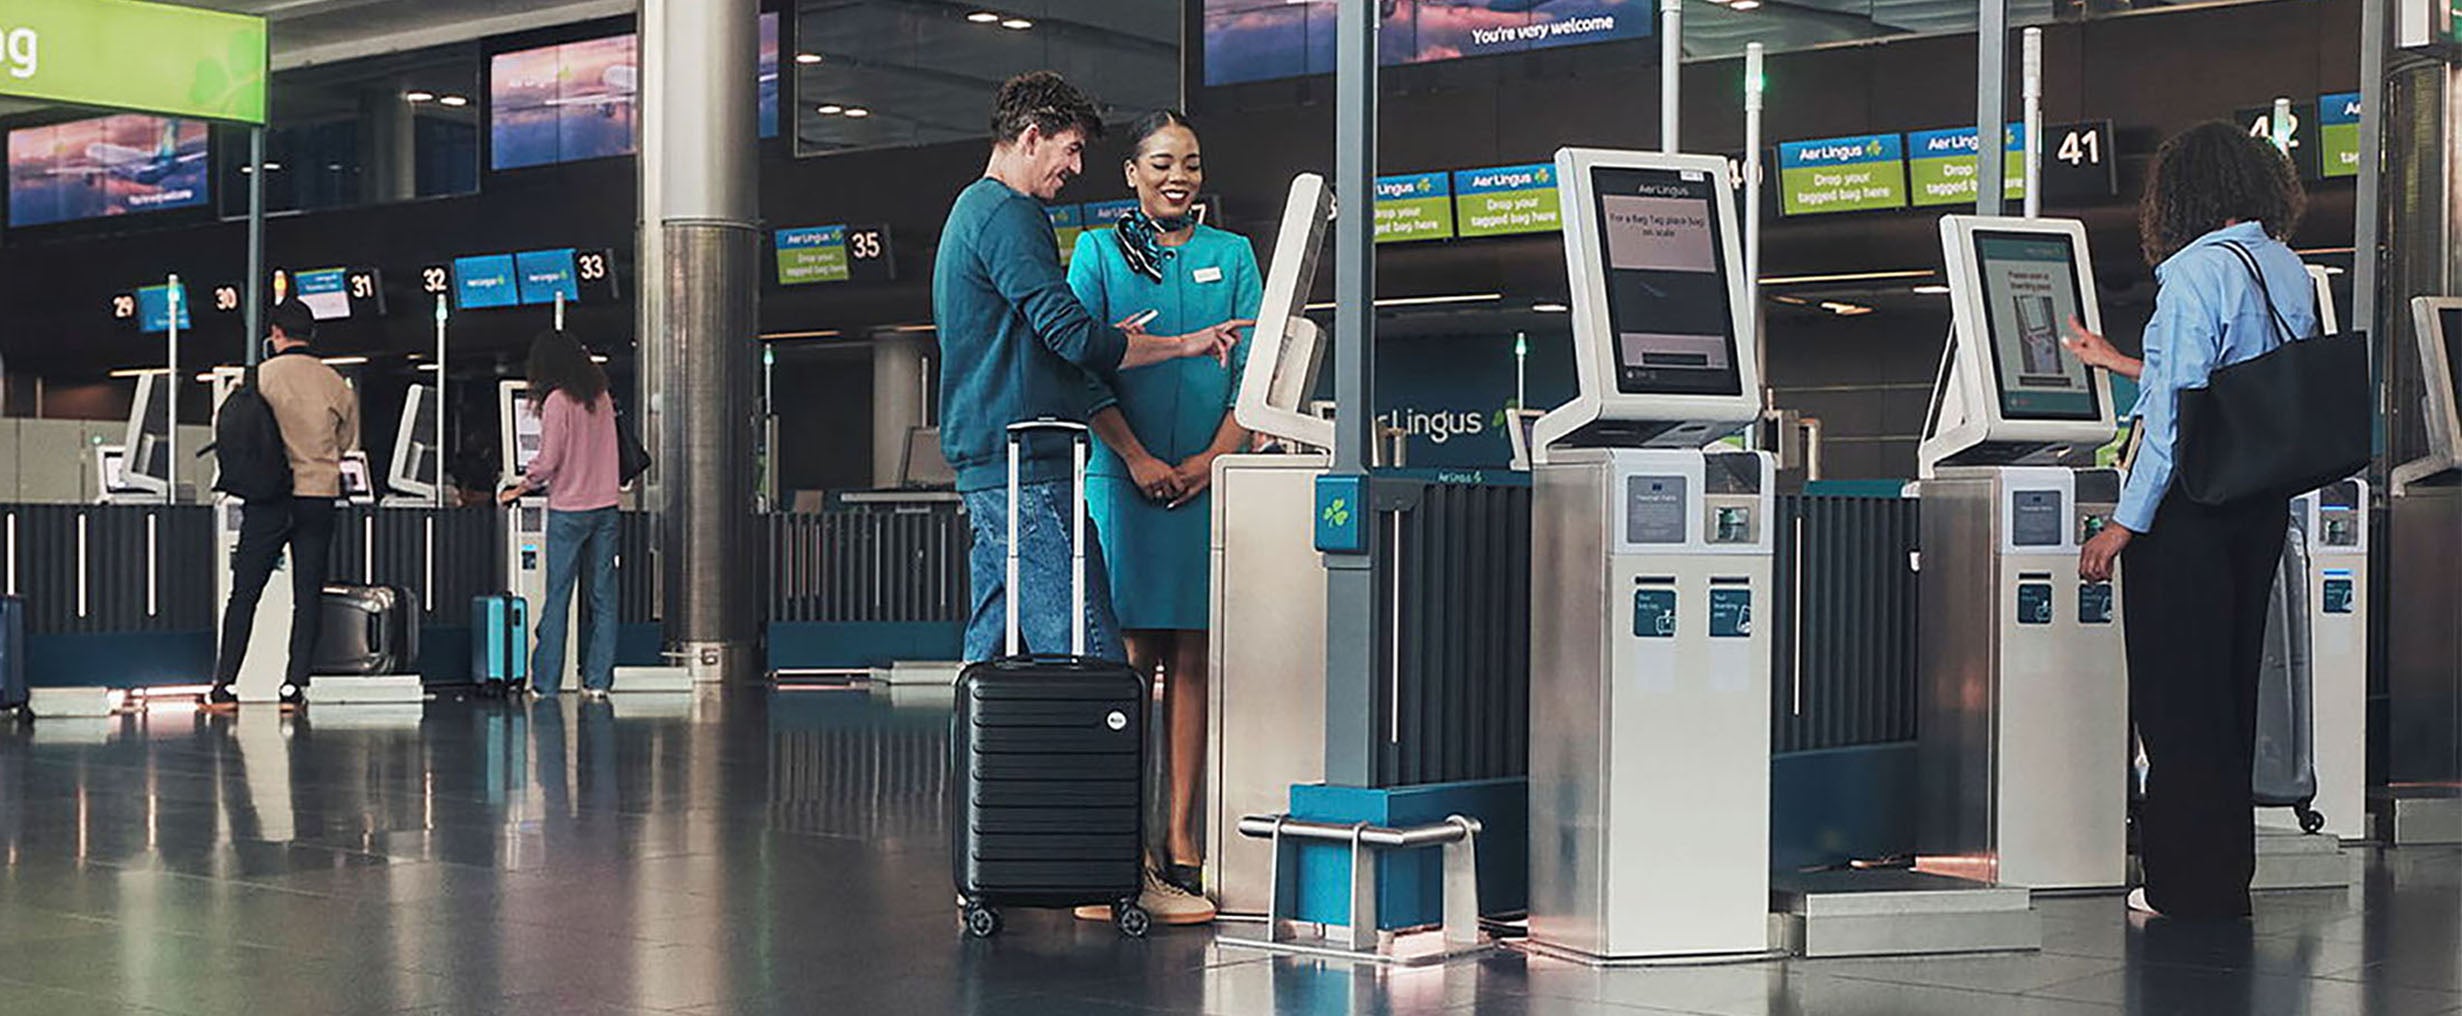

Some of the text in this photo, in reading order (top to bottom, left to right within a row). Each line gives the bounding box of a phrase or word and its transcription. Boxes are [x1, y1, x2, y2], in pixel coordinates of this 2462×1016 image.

[1471, 16, 1614, 46] You're very welcome
[0, 26, 38, 79] g
[1927, 133, 1979, 152] Aer Ling
[2057, 130, 2099, 166] 41
[1799, 144, 1863, 162] Aer Lingus
[1813, 171, 1872, 188] Drop your
[1943, 163, 1974, 178] Drop
[1376, 182, 1414, 198] Lingus
[1471, 172, 1533, 189] Aer Lingus
[1926, 179, 1968, 198] tagged
[1487, 197, 1539, 212] Drop your
[1797, 189, 1838, 206] tagged
[1839, 187, 1862, 203] bag
[1190, 203, 1207, 224] 7
[1374, 208, 1397, 220] rop
[1510, 211, 1530, 226] bag
[851, 231, 880, 258] 35
[578, 254, 605, 280] 33
[351, 275, 373, 299] 31
[423, 267, 448, 293] 32
[113, 295, 134, 318] 29
[214, 286, 238, 310] 30
